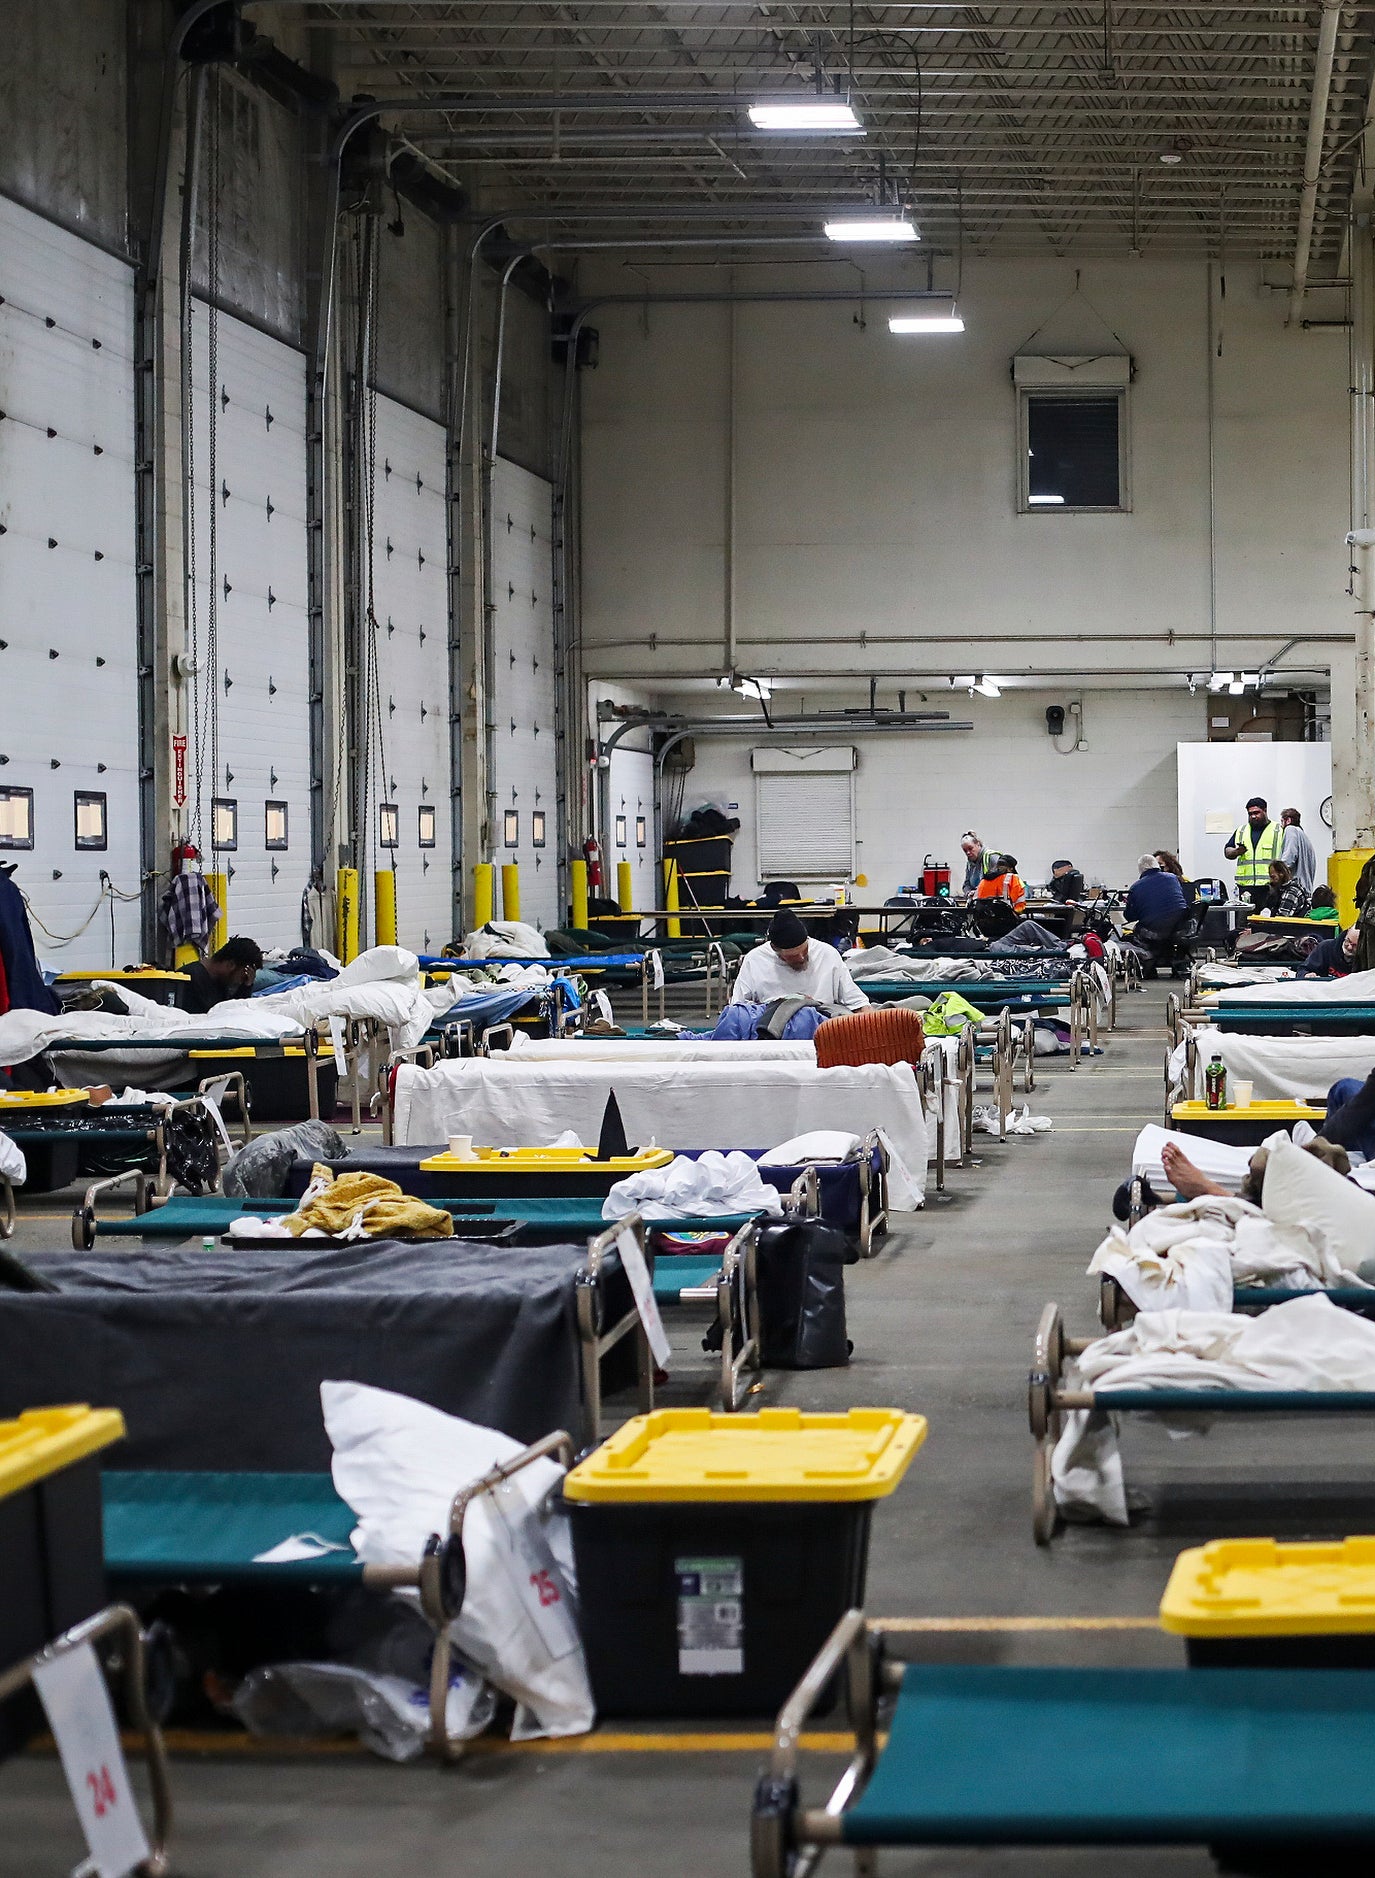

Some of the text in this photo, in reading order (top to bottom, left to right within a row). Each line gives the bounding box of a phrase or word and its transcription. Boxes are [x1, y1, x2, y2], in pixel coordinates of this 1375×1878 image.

[174, 739, 186, 747] FIRE
[530, 1569, 560, 1607] 25
[86, 1764, 117, 1819] 24
